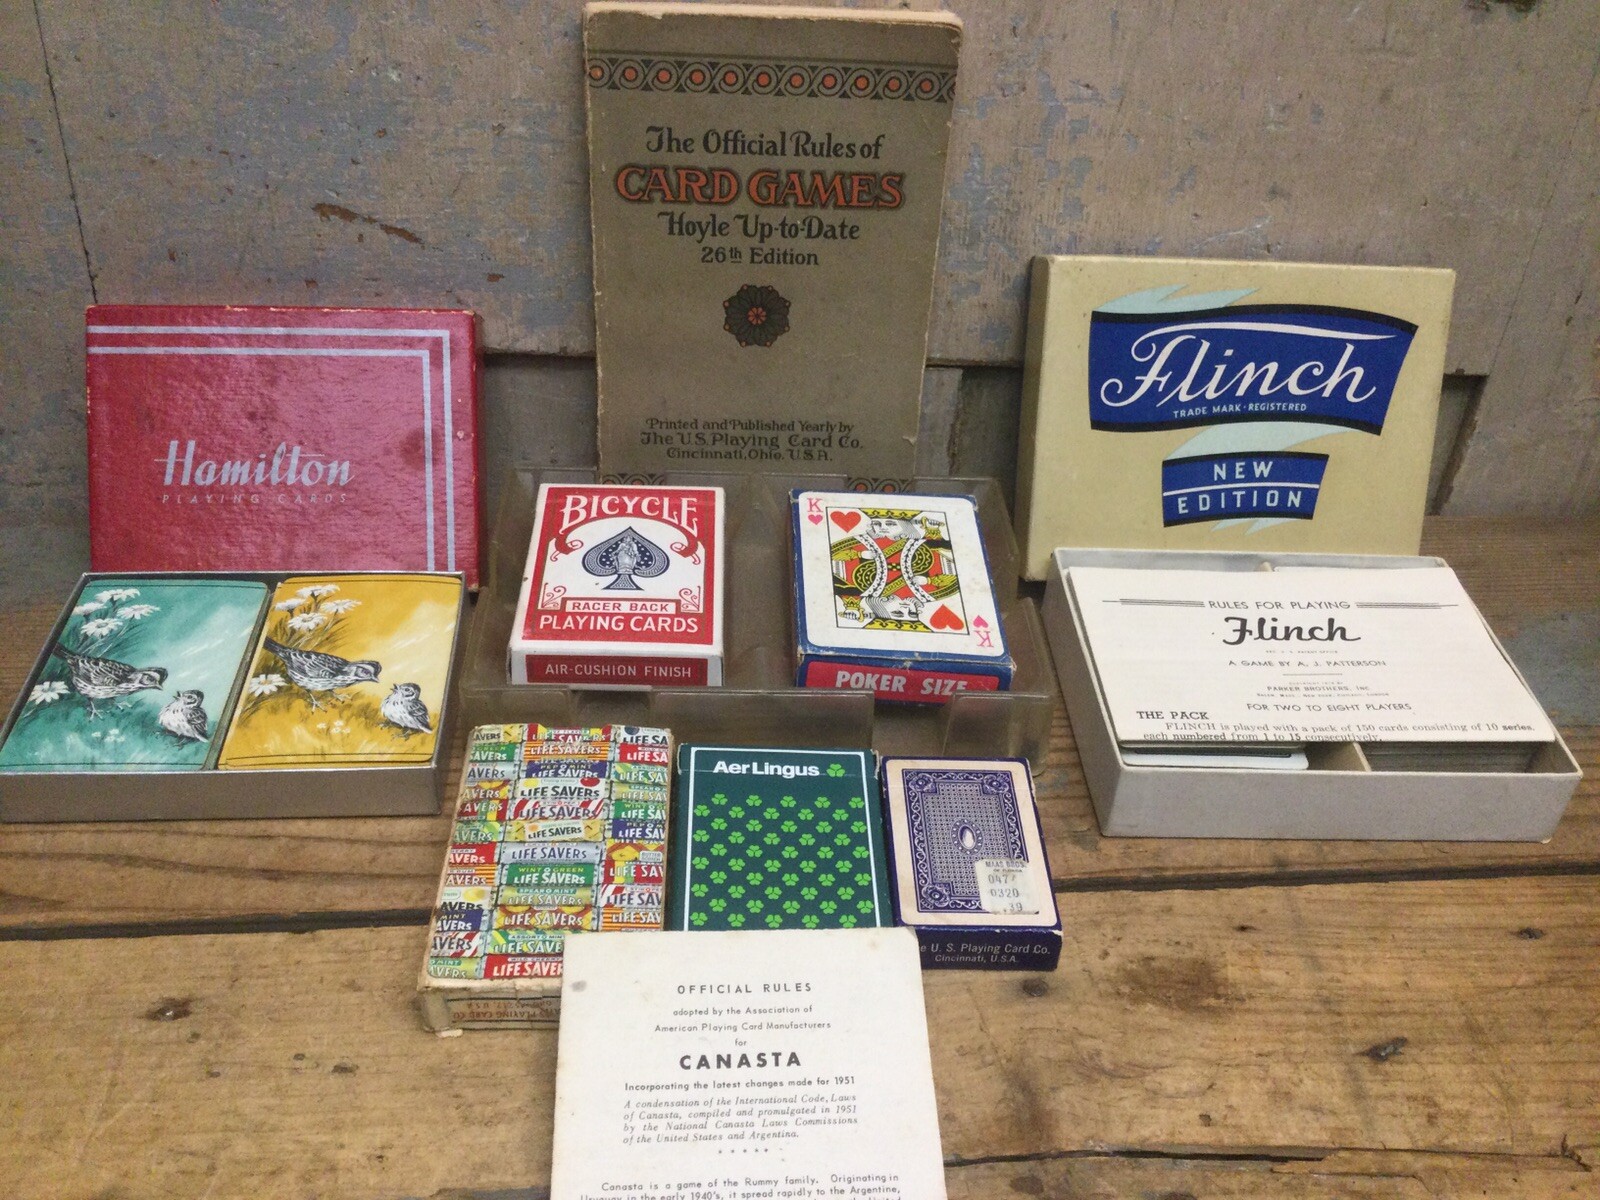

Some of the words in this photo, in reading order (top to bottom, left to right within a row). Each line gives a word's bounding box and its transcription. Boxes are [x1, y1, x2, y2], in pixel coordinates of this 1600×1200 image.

[646, 125, 694, 153] The
[702, 128, 786, 158] Official
[790, 131, 856, 158] Rules
[860, 134, 885, 160] of
[613, 163, 742, 206] CARD
[746, 168, 906, 211] GAMES
[658, 211, 730, 243] Hoyle
[734, 213, 861, 243] Up-to-Date
[700, 246, 742, 264] 26th
[749, 247, 819, 266] Edition
[1100, 321, 1397, 411] Flinch
[1173, 407, 1207, 419] TRADE
[646, 418, 698, 430] Printed
[703, 420, 728, 431] and
[729, 419, 795, 432] Published
[799, 421, 837, 435] Yearly
[839, 421, 855, 434] by
[640, 432, 673, 446] The
[711, 433, 779, 449] Playing
[788, 435, 832, 448] Card
[839, 436, 863, 449] Co.
[154, 440, 354, 486] Hamilton
[1214, 461, 1273, 481] NEW
[163, 494, 259, 503] PLAYING
[278, 494, 346, 503] CARDS
[807, 498, 823, 512] K
[1178, 491, 1302, 514] EDITION
[559, 494, 698, 538] BICYCLE
[572, 602, 621, 611] RACER
[630, 603, 668, 612] BACK
[1209, 601, 1248, 609] RULES
[1256, 601, 1283, 609] FOR
[1291, 601, 1350, 609] PLAYING
[540, 615, 624, 631] PLAYING
[630, 617, 698, 633] CARDS
[1223, 616, 1361, 645] Flinch
[976, 630, 994, 647] K
[545, 664, 636, 676] AIR-CUSHION
[644, 665, 691, 677] FINISH
[836, 671, 906, 692] POKER
[921, 678, 968, 695] SIZE
[1136, 711, 1165, 719] THE
[1166, 723, 1216, 731] FLINCH
[1233, 724, 1269, 732] played
[1308, 724, 1337, 733] pack
[1341, 724, 1352, 732] of
[1356, 724, 1375, 732] 150
[1412, 723, 1466, 733] consisting
[1471, 723, 1482, 731] of
[1486, 723, 1498, 731] 10
[1231, 733, 1258, 741] from
[1273, 733, 1285, 741] to
[531, 744, 555, 755] LIFE
[557, 744, 600, 755] SAVERS
[713, 761, 750, 774] Aer
[752, 762, 820, 778] Lingus
[520, 786, 548, 796] LIFE
[551, 786, 599, 797] SAVERS
[519, 807, 549, 818] LIFE
[551, 806, 596, 817] SAVERS
[528, 828, 548, 839] LIFE
[549, 827, 582, 837] SAVERS
[512, 849, 540, 859] LIFE
[543, 847, 587, 859] SAVERS
[514, 874, 538, 884] LIFE
[541, 873, 585, 884] SAVERS
[504, 912, 530, 926] LIFE
[532, 912, 583, 926] SAVERS
[961, 944, 1000, 954] Playing
[1005, 944, 1030, 953] Card
[1033, 945, 1050, 954] Co.
[935, 955, 986, 963] Cincinnati,
[493, 963, 521, 976] LIFE
[677, 984, 752, 995] OFFICIAL
[763, 982, 812, 992] RULES
[673, 1007, 709, 1016] adopted
[712, 1007, 723, 1016] by
[727, 1007, 741, 1015] the
[745, 1005, 800, 1015] Association
[803, 1005, 812, 1013] of
[655, 1024, 697, 1032] American
[702, 1023, 737, 1032] Playing
[742, 1022, 762, 1030] Card
[766, 1021, 831, 1030] Manufacturers
[735, 1038, 746, 1046] for
[680, 1052, 801, 1070] CANASTA
[625, 1082, 689, 1092] Incorporating
[694, 1081, 708, 1089] the
[713, 1081, 740, 1089] latest
[746, 1080, 784, 1088] changes
[788, 1078, 812, 1086] made
[817, 1077, 829, 1085] for
[835, 1076, 854, 1085] 1951
[624, 1100, 630, 1108] A
[636, 1099, 699, 1108] condensation
[704, 1098, 713, 1107] of
[717, 1097, 731, 1105] the
[736, 1095, 797, 1105] International
[801, 1095, 828, 1103] Code,
[831, 1094, 856, 1102] Laws
[624, 1111, 634, 1122] of
[639, 1111, 682, 1120] Canasta,
[688, 1109, 731, 1119] compiled
[736, 1107, 753, 1116] and
[758, 1106, 816, 1117] promulgated
[836, 1105, 856, 1113] 1951
[624, 1124, 634, 1133] by
[643, 1123, 658, 1131] the
[666, 1121, 707, 1131] National
[715, 1120, 754, 1129] Canasta
[762, 1119, 787, 1127] Laws
[795, 1117, 857, 1126] Commissions
[623, 1136, 633, 1145] of
[637, 1135, 651, 1143] the
[657, 1134, 689, 1142] United
[693, 1133, 722, 1141] States
[728, 1131, 744, 1139] and
[749, 1130, 799, 1140] Argentina.
